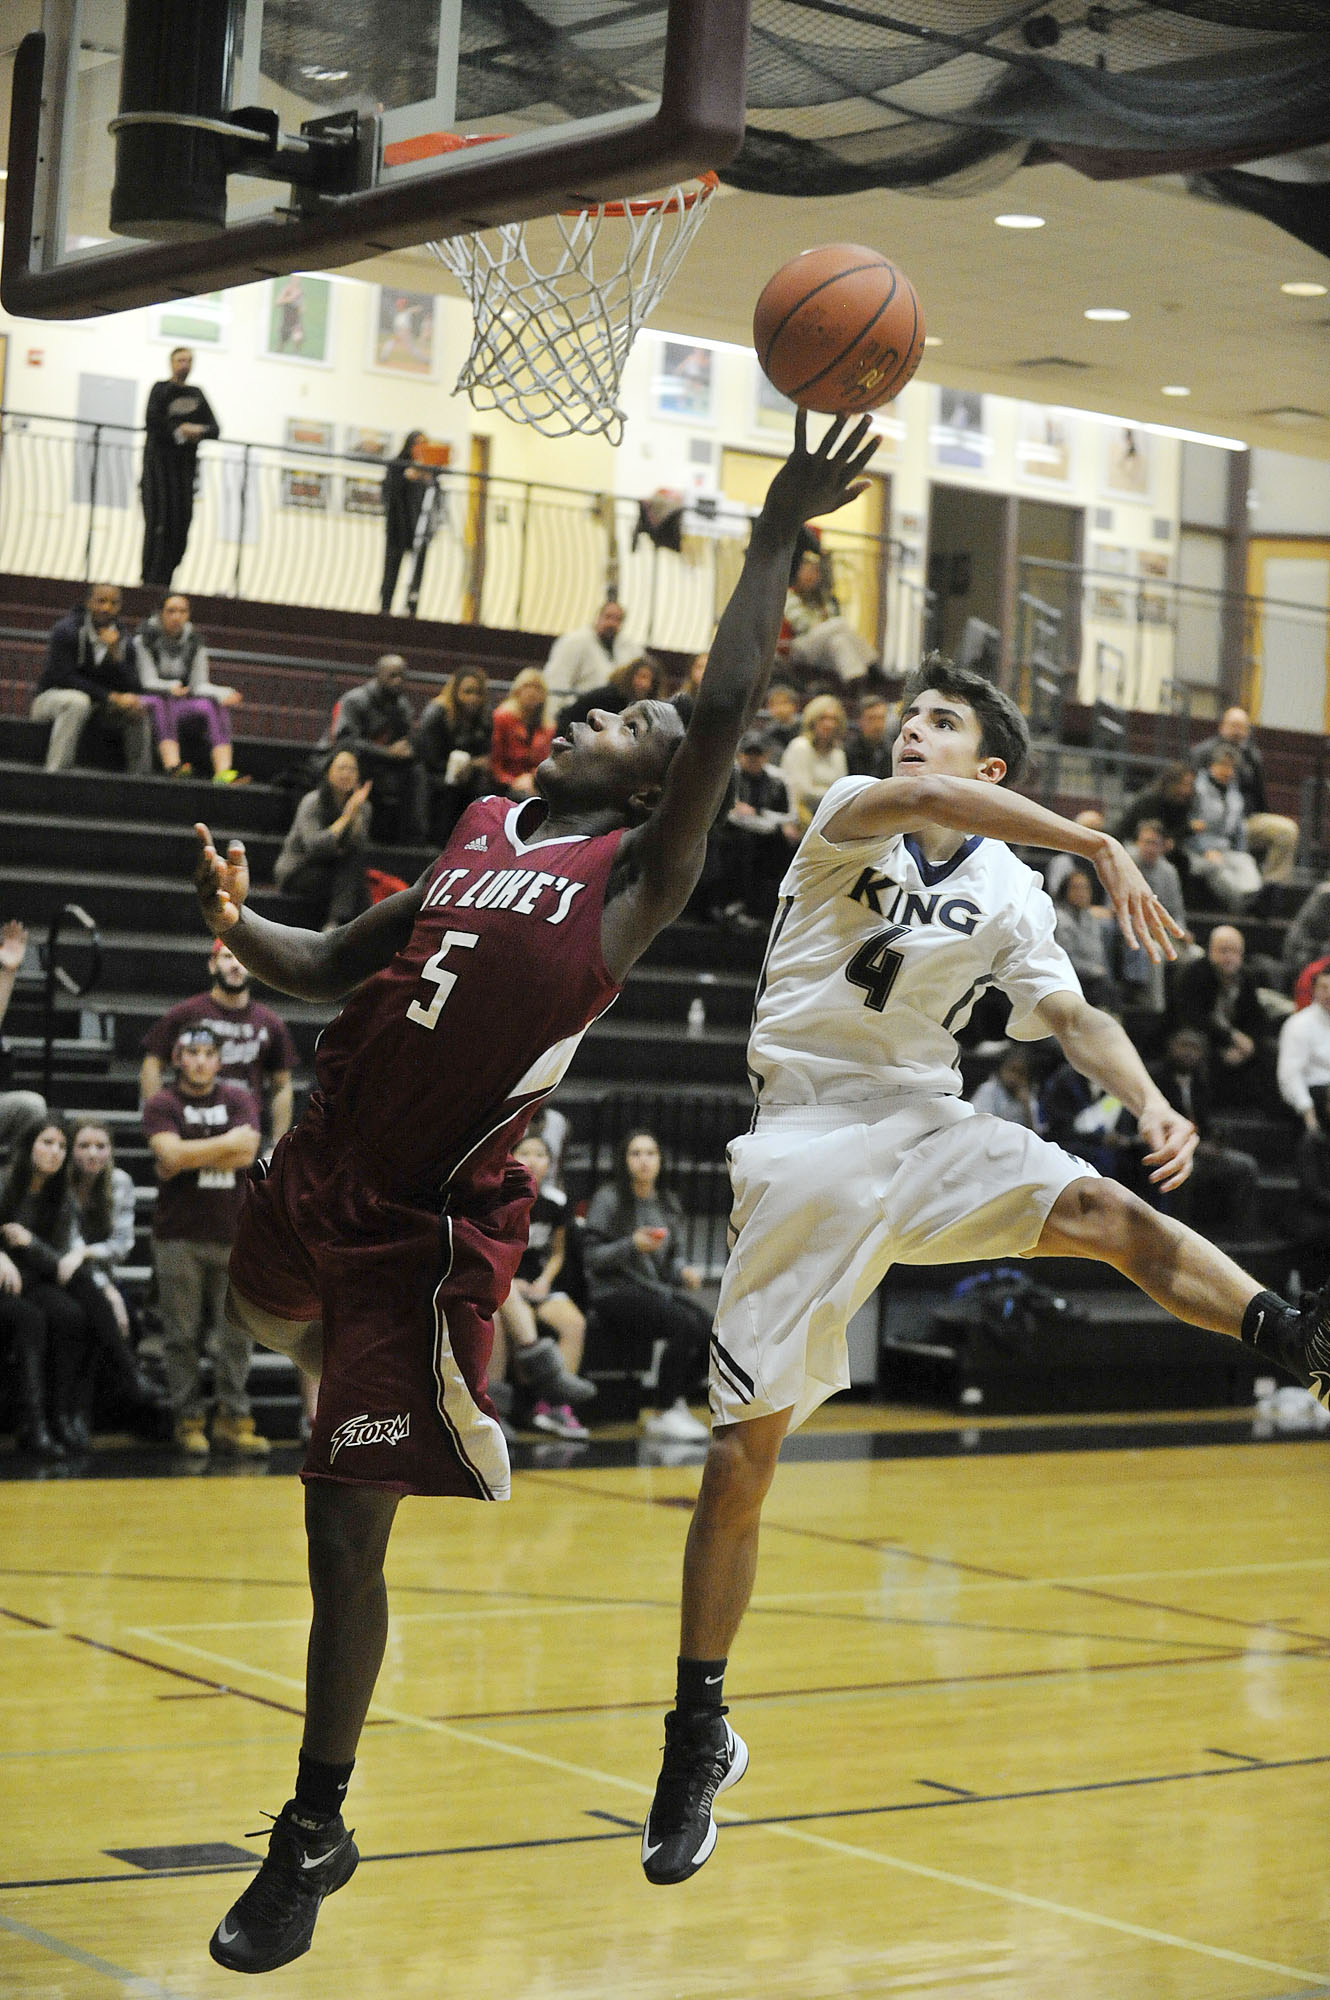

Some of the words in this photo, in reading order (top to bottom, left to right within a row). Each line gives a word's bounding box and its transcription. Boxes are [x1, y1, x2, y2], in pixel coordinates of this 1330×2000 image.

[464, 843, 488, 853] adidas
[454, 869, 586, 925] LUKE'S
[848, 866, 984, 936] KING
[406, 930, 480, 1030] 5
[845, 924, 912, 1013] 4
[330, 1412, 410, 1465] STORM
